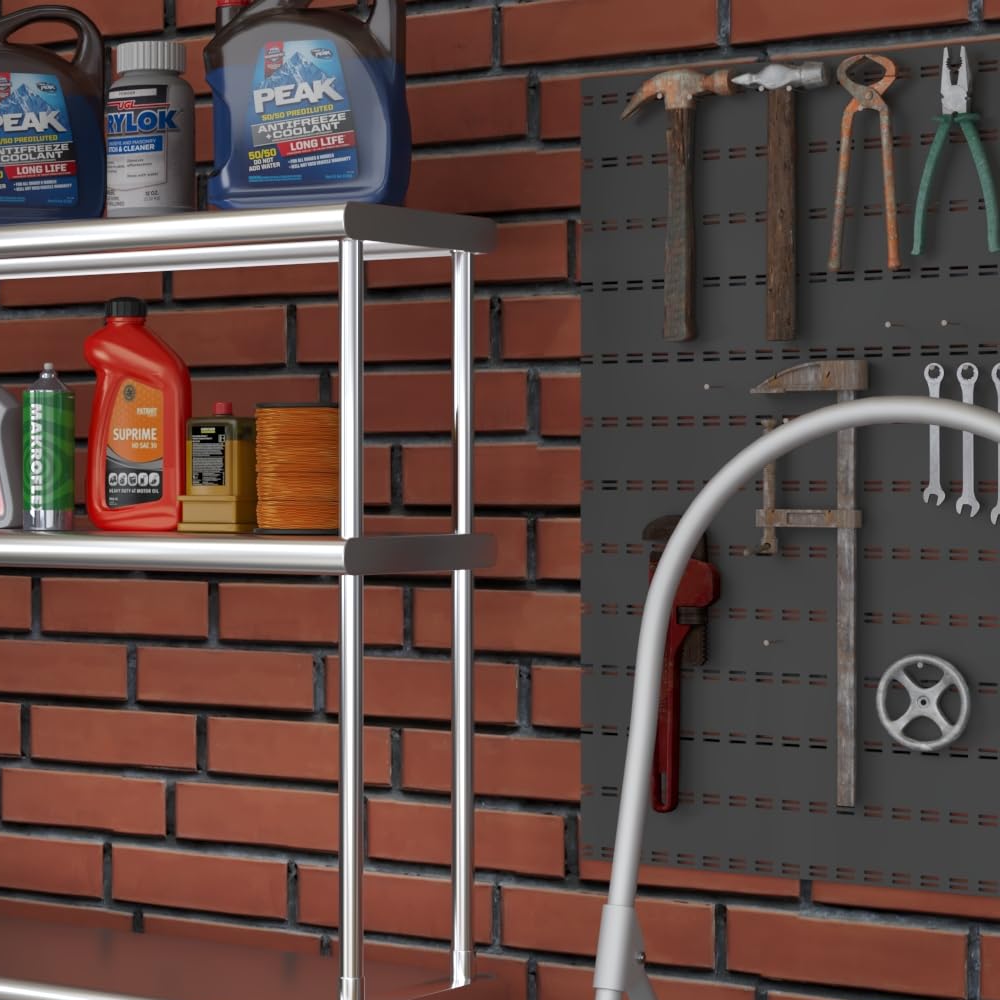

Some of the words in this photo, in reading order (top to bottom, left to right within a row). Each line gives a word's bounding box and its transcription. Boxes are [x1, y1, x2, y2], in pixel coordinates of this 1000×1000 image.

[253, 77, 344, 113] PEAK
[118, 100, 135, 110] UGL
[286, 104, 333, 117] PREDILUTED
[258, 112, 346, 133] ANTIFREEZE
[14, 134, 57, 143] PREDILUTED
[290, 138, 318, 151] LONG
[320, 135, 345, 146] LIFE
[123, 144, 155, 152] CLEANER
[248, 148, 276, 160] 50/50
[16, 164, 42, 176] LONG
[45, 163, 67, 173] LIFE
[261, 161, 280, 170] WATER
[113, 428, 157, 441] SUPRIME
